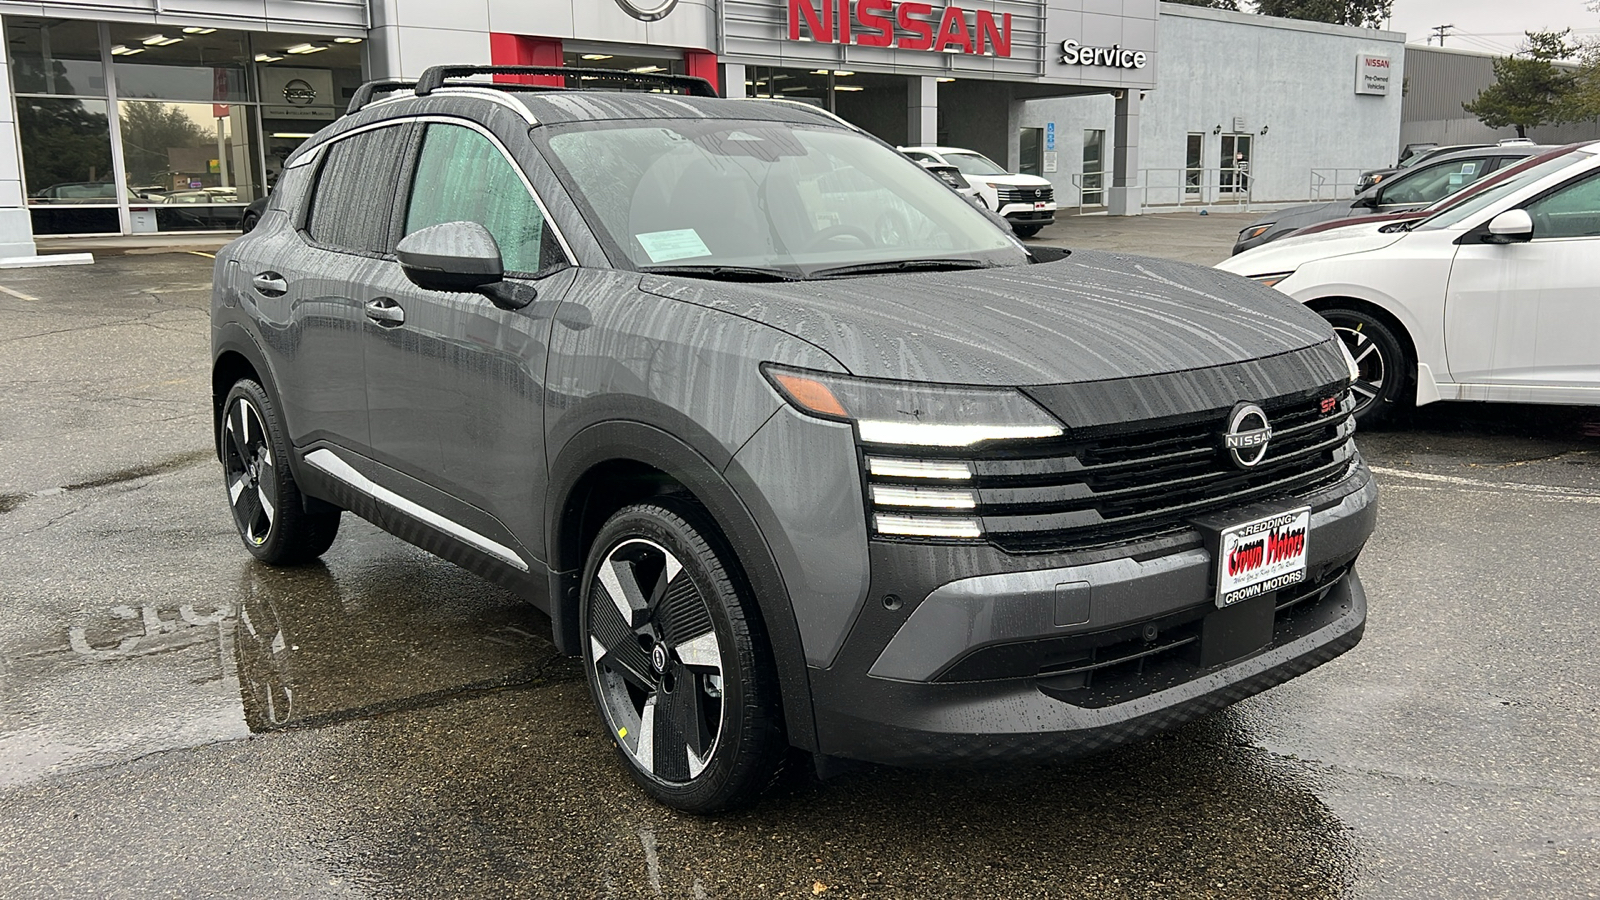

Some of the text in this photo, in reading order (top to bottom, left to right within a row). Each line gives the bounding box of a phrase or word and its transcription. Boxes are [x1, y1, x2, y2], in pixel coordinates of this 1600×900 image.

[788, 0, 1012, 58] NISSAN
[1061, 38, 1147, 69] Service
[1365, 58, 1390, 68] NISSAN
[1364, 74, 1388, 82] Pre-Owned
[1321, 398, 1336, 413] SR
[1228, 429, 1272, 447] NISSAN
[1246, 515, 1291, 535] REDDING
[1228, 528, 1305, 577] Crown Motors
[1225, 570, 1302, 604] CROWN MOTORS
